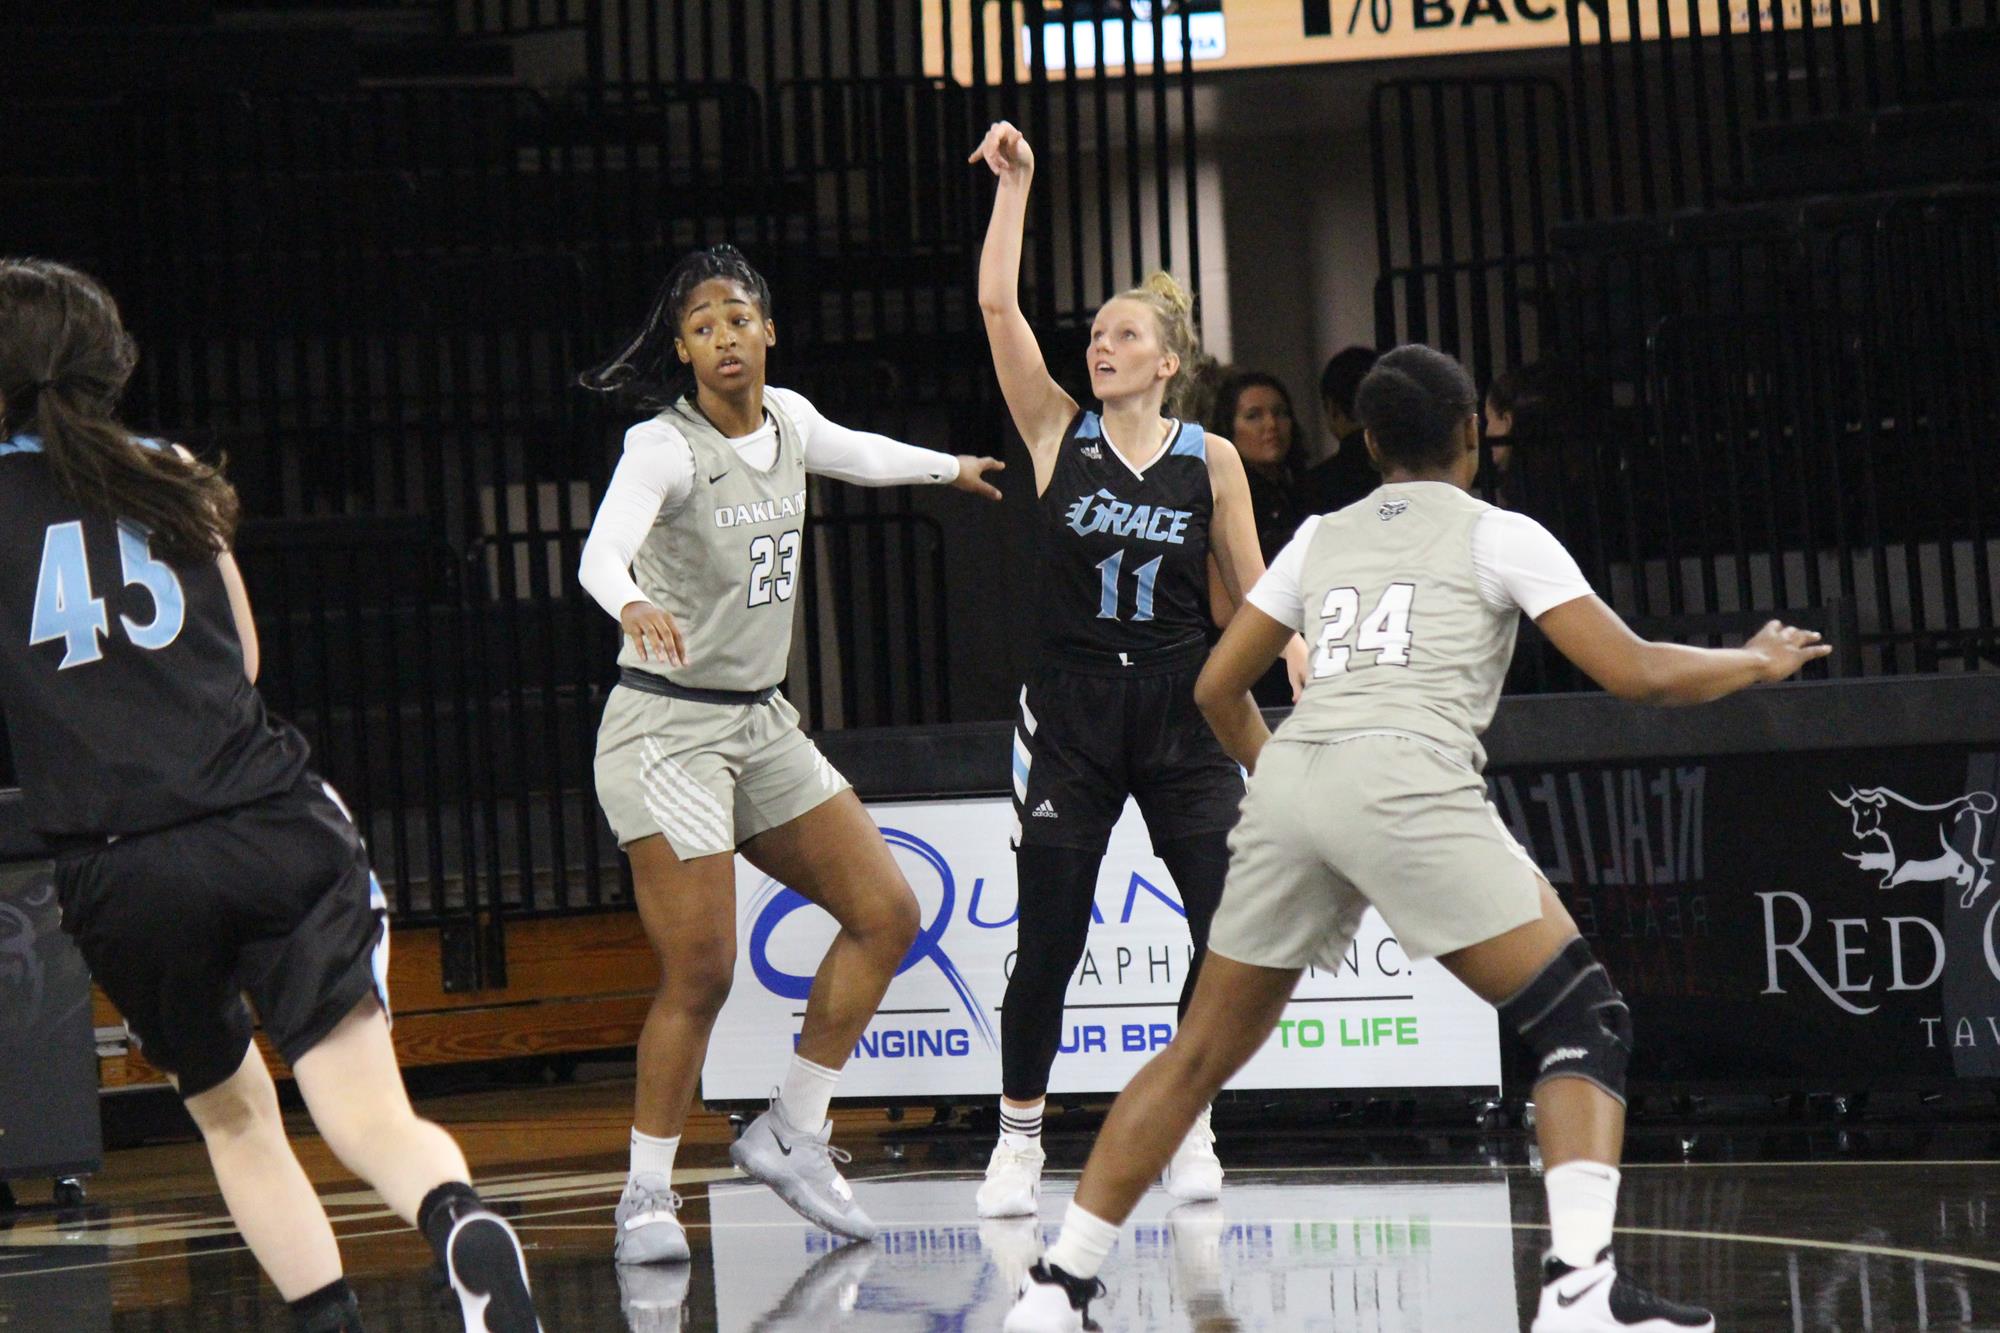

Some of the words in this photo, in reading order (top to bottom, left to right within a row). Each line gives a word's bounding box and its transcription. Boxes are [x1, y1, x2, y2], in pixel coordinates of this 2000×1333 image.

[714, 489, 807, 528] OAKLAN
[1065, 488, 1193, 544] GRACE
[29, 520, 186, 671] 45
[747, 529, 800, 609] 23
[1095, 549, 1164, 622] 11
[1313, 582, 1417, 679] 24
[1754, 890, 1946, 1015] RED
[793, 1028, 970, 1059] NGING
[1058, 1026, 1107, 1053] UR
[1279, 1019, 1325, 1048] TO
[1340, 1017, 1419, 1046] LIFE
